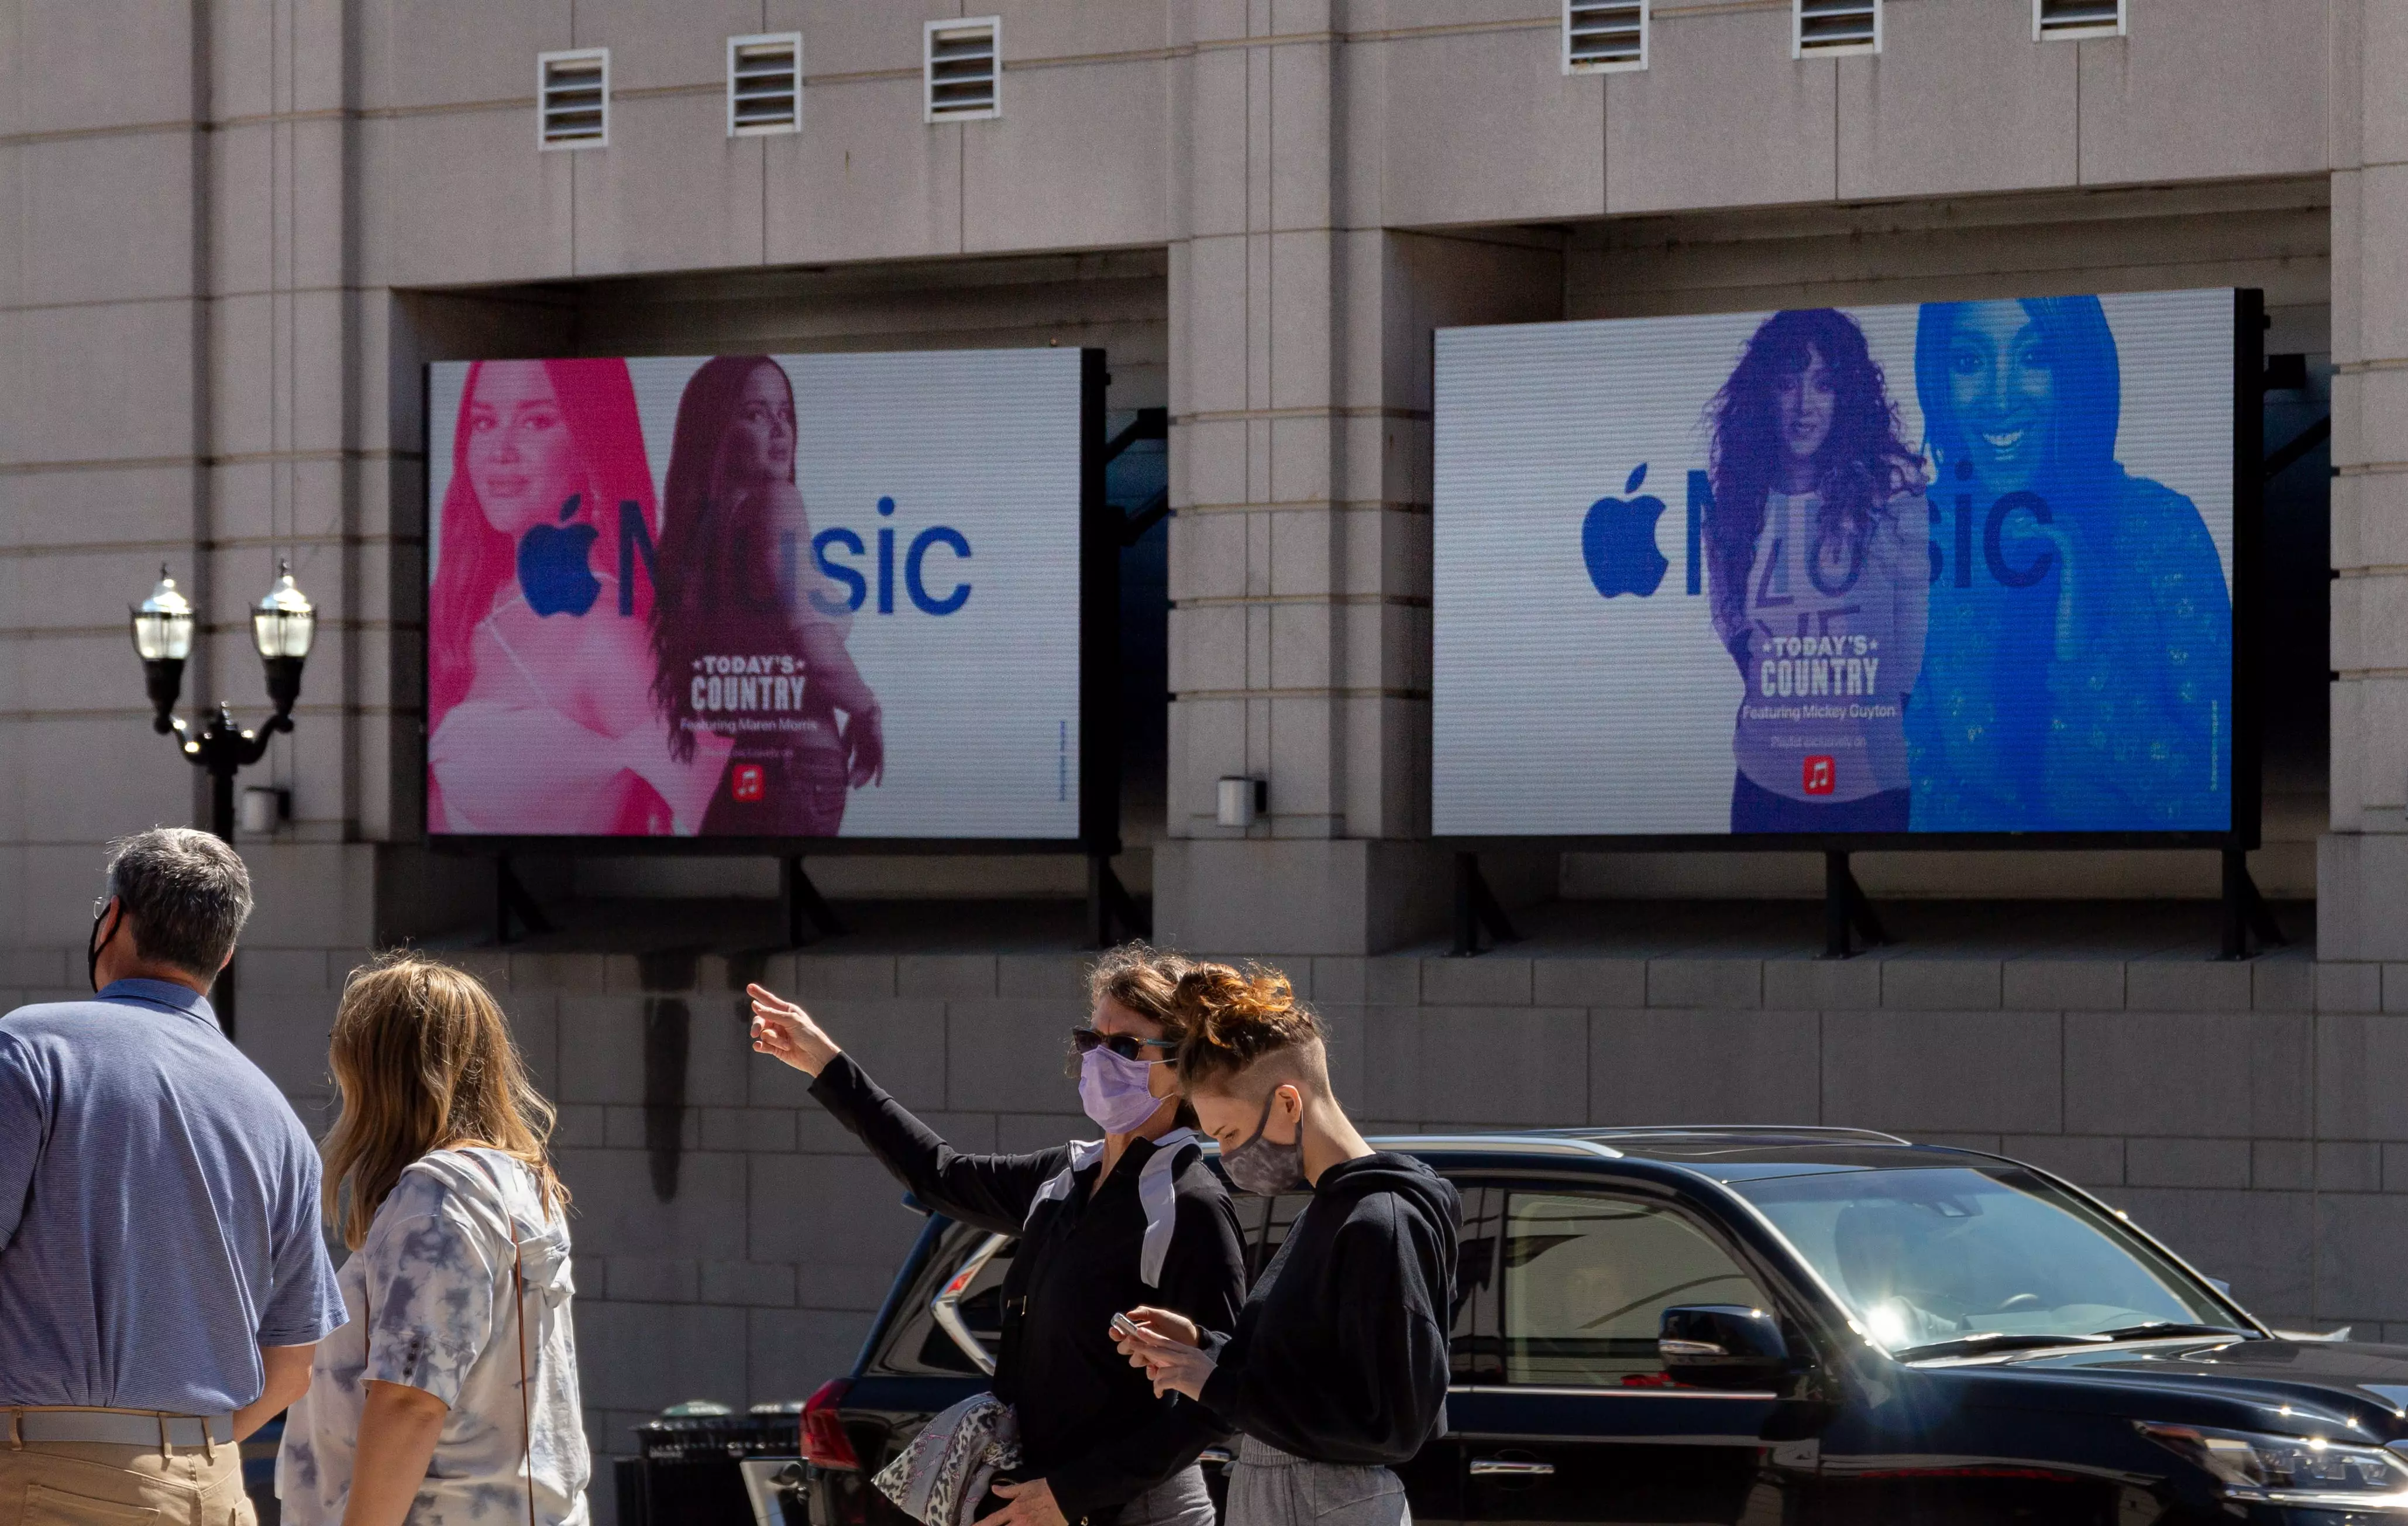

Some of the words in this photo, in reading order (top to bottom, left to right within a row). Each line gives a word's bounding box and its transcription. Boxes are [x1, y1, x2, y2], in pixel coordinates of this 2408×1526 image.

[1773, 635, 1867, 657] TODAY'S
[703, 655, 794, 674] TODAY'S
[1760, 658, 1879, 697] COUNTRY
[691, 676, 806, 712] COUNTRY
[1743, 706, 1800, 721] Featuring
[1803, 705, 1846, 720] Mickey
[1849, 704, 1896, 720] Guyton
[738, 719, 776, 730] Maren
[779, 718, 818, 731] Morris
